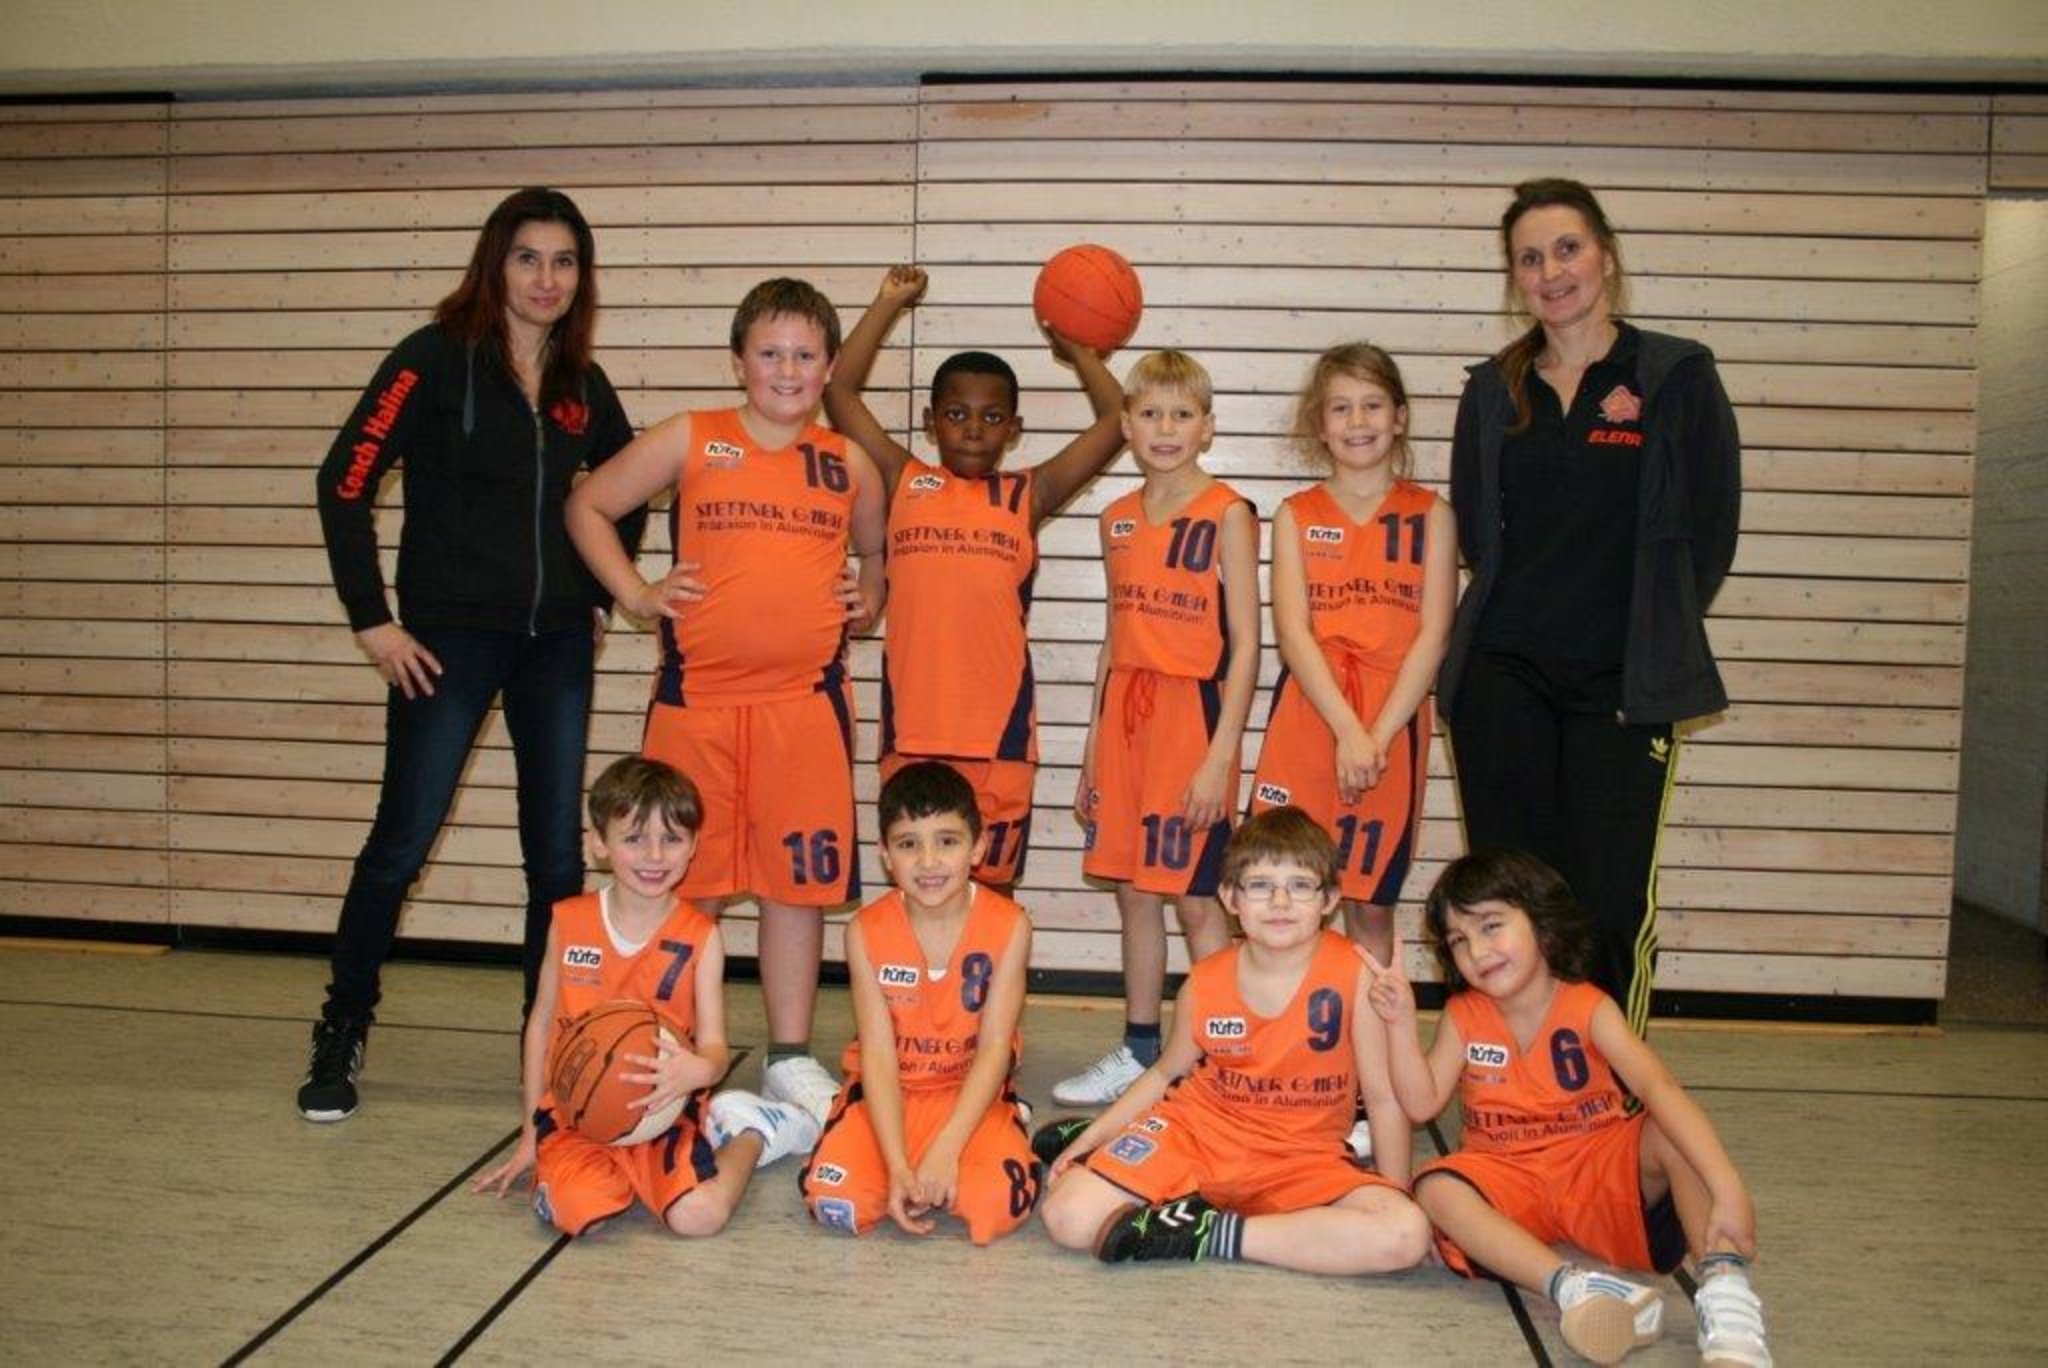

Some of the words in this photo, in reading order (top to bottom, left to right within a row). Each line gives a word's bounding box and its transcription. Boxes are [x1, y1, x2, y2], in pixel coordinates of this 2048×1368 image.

[336, 441, 380, 499] Coach
[362, 369, 419, 440] Halina
[797, 443, 850, 493] 16
[979, 472, 1027, 514] 17
[1166, 517, 1217, 573] 10
[1378, 513, 1426, 565] 11
[782, 828, 842, 886] 16
[1141, 813, 1193, 871] 10
[1336, 814, 1384, 876] 11
[655, 938, 694, 1002] 7
[961, 952, 993, 1013] 8
[1307, 987, 1344, 1053] 9
[1550, 1027, 1590, 1092] 6
[1002, 1157, 1031, 1219] 8
